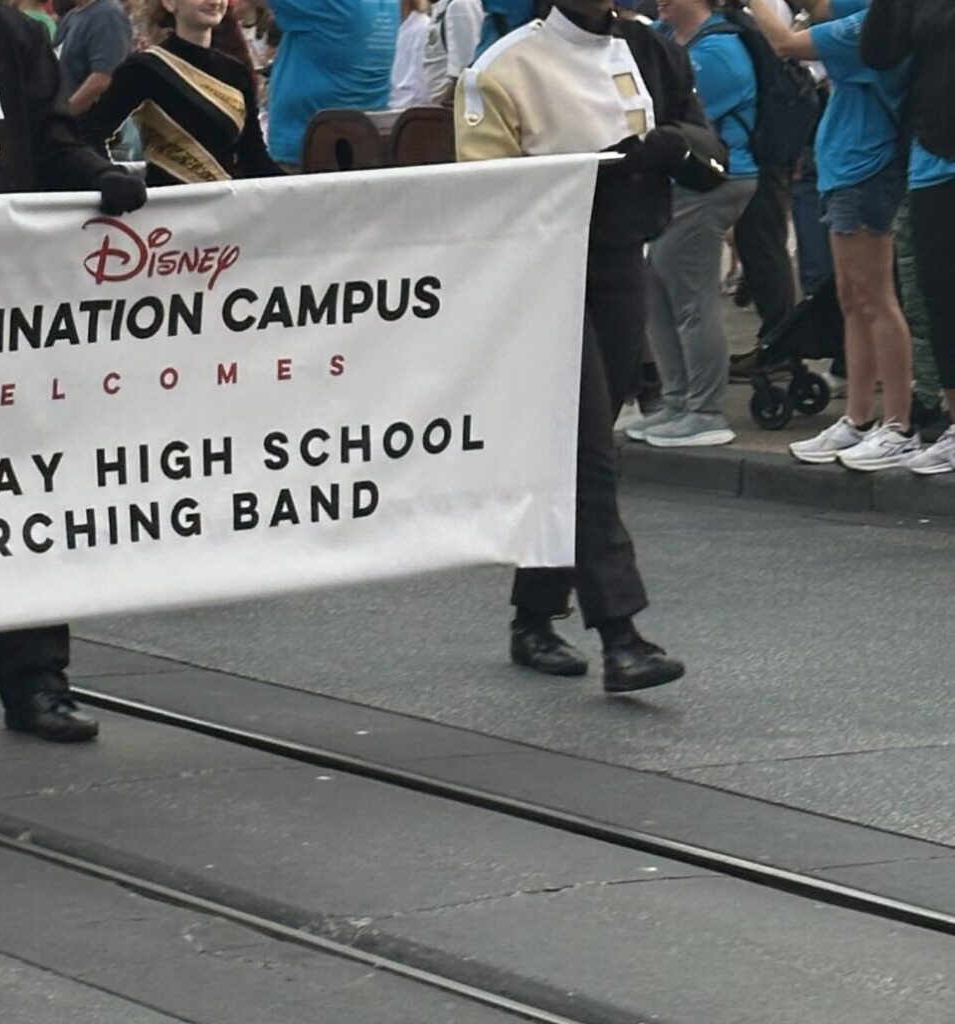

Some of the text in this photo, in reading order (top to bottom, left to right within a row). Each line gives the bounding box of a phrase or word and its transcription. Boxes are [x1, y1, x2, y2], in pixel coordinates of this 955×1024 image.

[222, 276, 442, 333] CAMPUS
[96, 437, 232, 487] HIGH
[264, 414, 484, 471] SCHOOL
[232, 480, 379, 531] BAND
